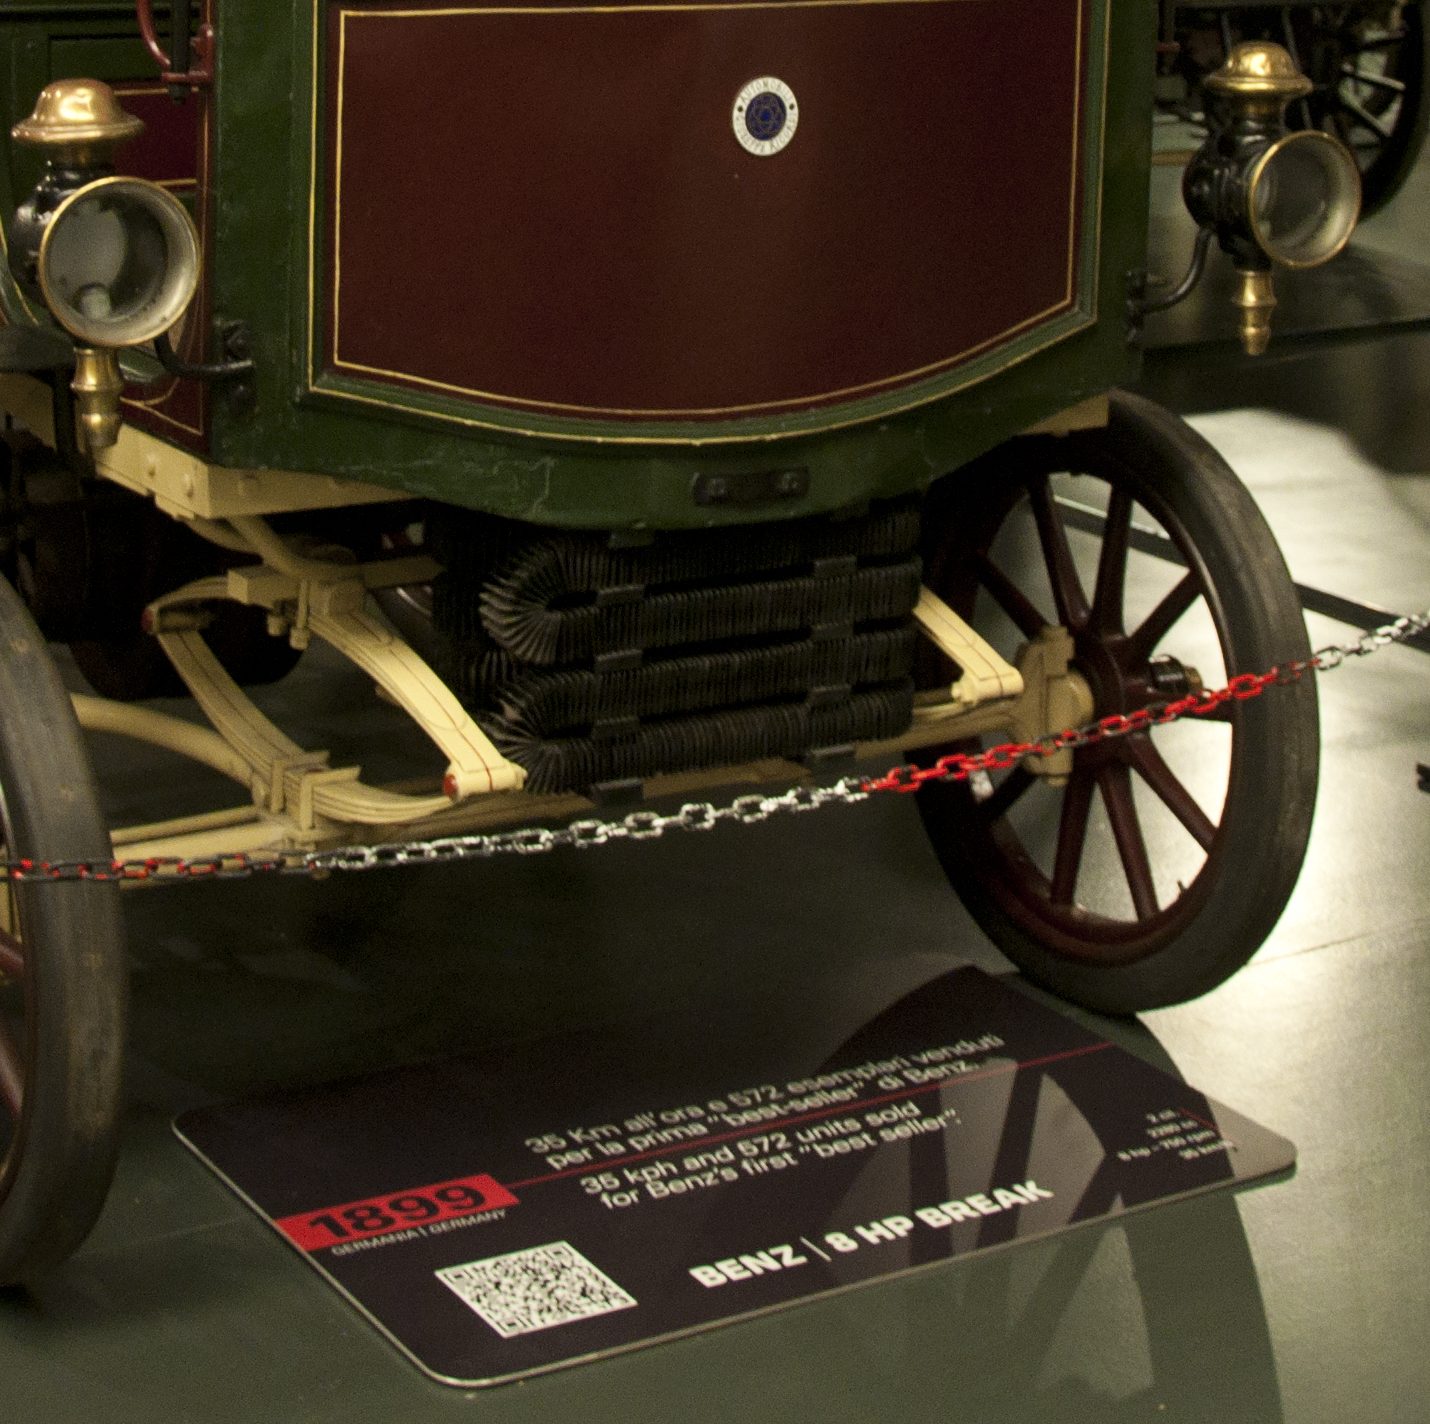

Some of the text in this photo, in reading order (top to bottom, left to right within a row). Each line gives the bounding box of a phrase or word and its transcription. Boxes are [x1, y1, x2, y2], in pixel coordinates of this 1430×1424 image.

[524, 1033, 1005, 1154] 35 Km all'ora e 572 esemplari venduti
[546, 1147, 593, 1171] per
[594, 1141, 627, 1156] la
[628, 1122, 709, 1152] prima
[878, 1075, 905, 1091] di
[580, 1100, 921, 1195] 35 kph and 572 units sold
[600, 1188, 640, 1210] for
[645, 1167, 739, 1199] Benz's
[741, 1151, 799, 1177] first
[309, 1185, 486, 1238] 1899
[331, 1228, 421, 1257] GERMANIA
[429, 1208, 507, 1235] GERMANY
[689, 1244, 808, 1288] BENZ
[825, 1231, 859, 1253] 8
[854, 1215, 914, 1245] HP
[915, 1179, 1054, 1228] BREAK
